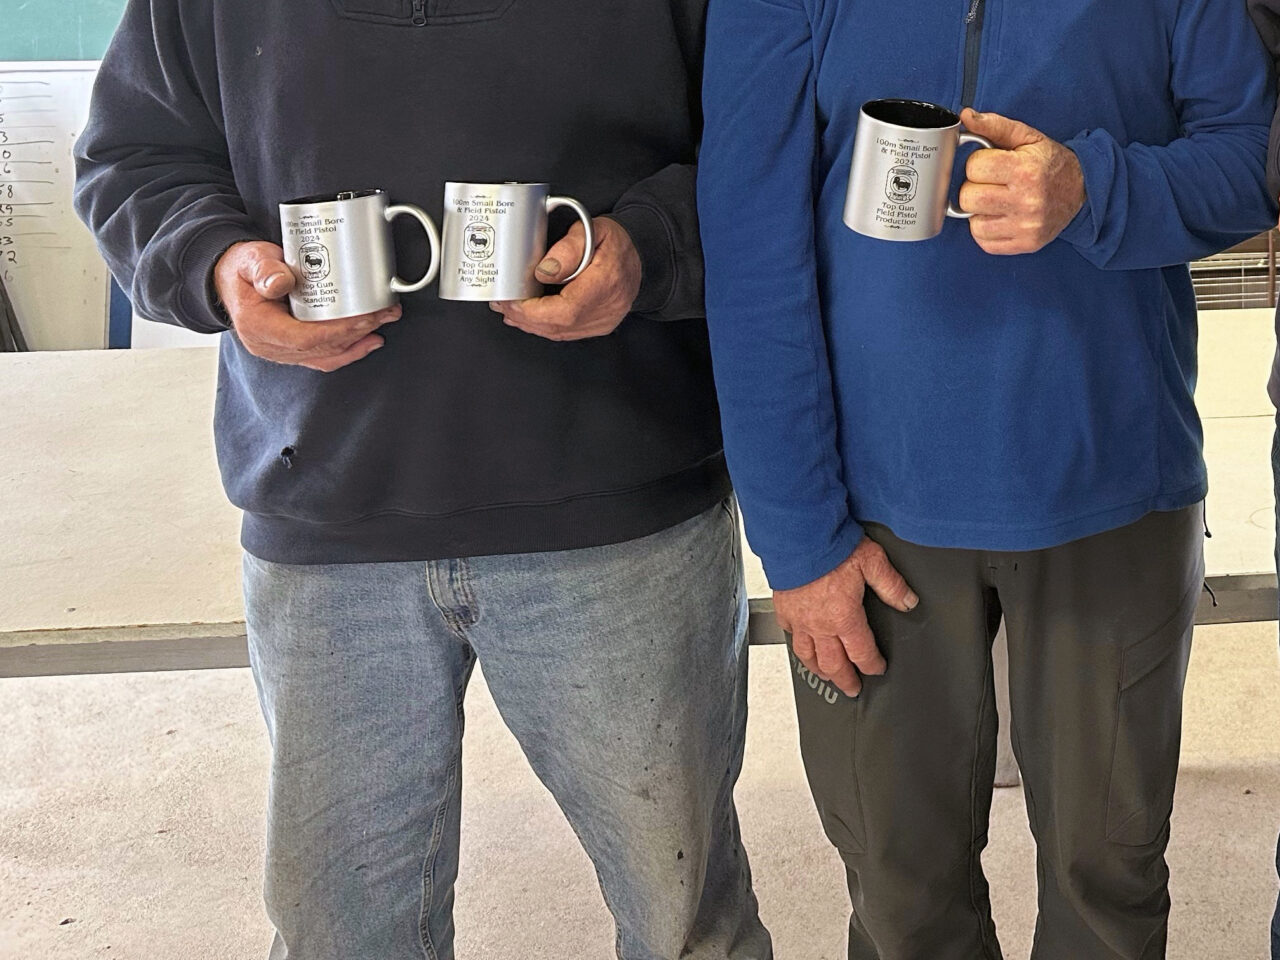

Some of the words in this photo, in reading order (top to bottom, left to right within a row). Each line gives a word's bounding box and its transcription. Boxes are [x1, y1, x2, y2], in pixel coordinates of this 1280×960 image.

[876, 137, 897, 148] 100m
[898, 142, 921, 152] Small
[890, 147, 909, 158] Field
[911, 151, 931, 159] Pistol
[894, 157, 915, 166] 2024
[882, 202, 897, 212] Top
[898, 203, 915, 211] Gun
[876, 208, 895, 217] Field
[897, 209, 918, 219] Pistol
[300, 220, 322, 228] Small
[325, 217, 345, 226] Bore
[875, 215, 917, 225] Production
[295, 228, 312, 236] Field
[314, 226, 337, 234] Pistol
[301, 235, 320, 243] 2024
[477, 268, 498, 276] Pistol
[316, 281, 334, 289] Gun
[476, 276, 495, 284] Sight
[303, 296, 336, 304] Standing
[797, 662, 838, 704] KUIU
